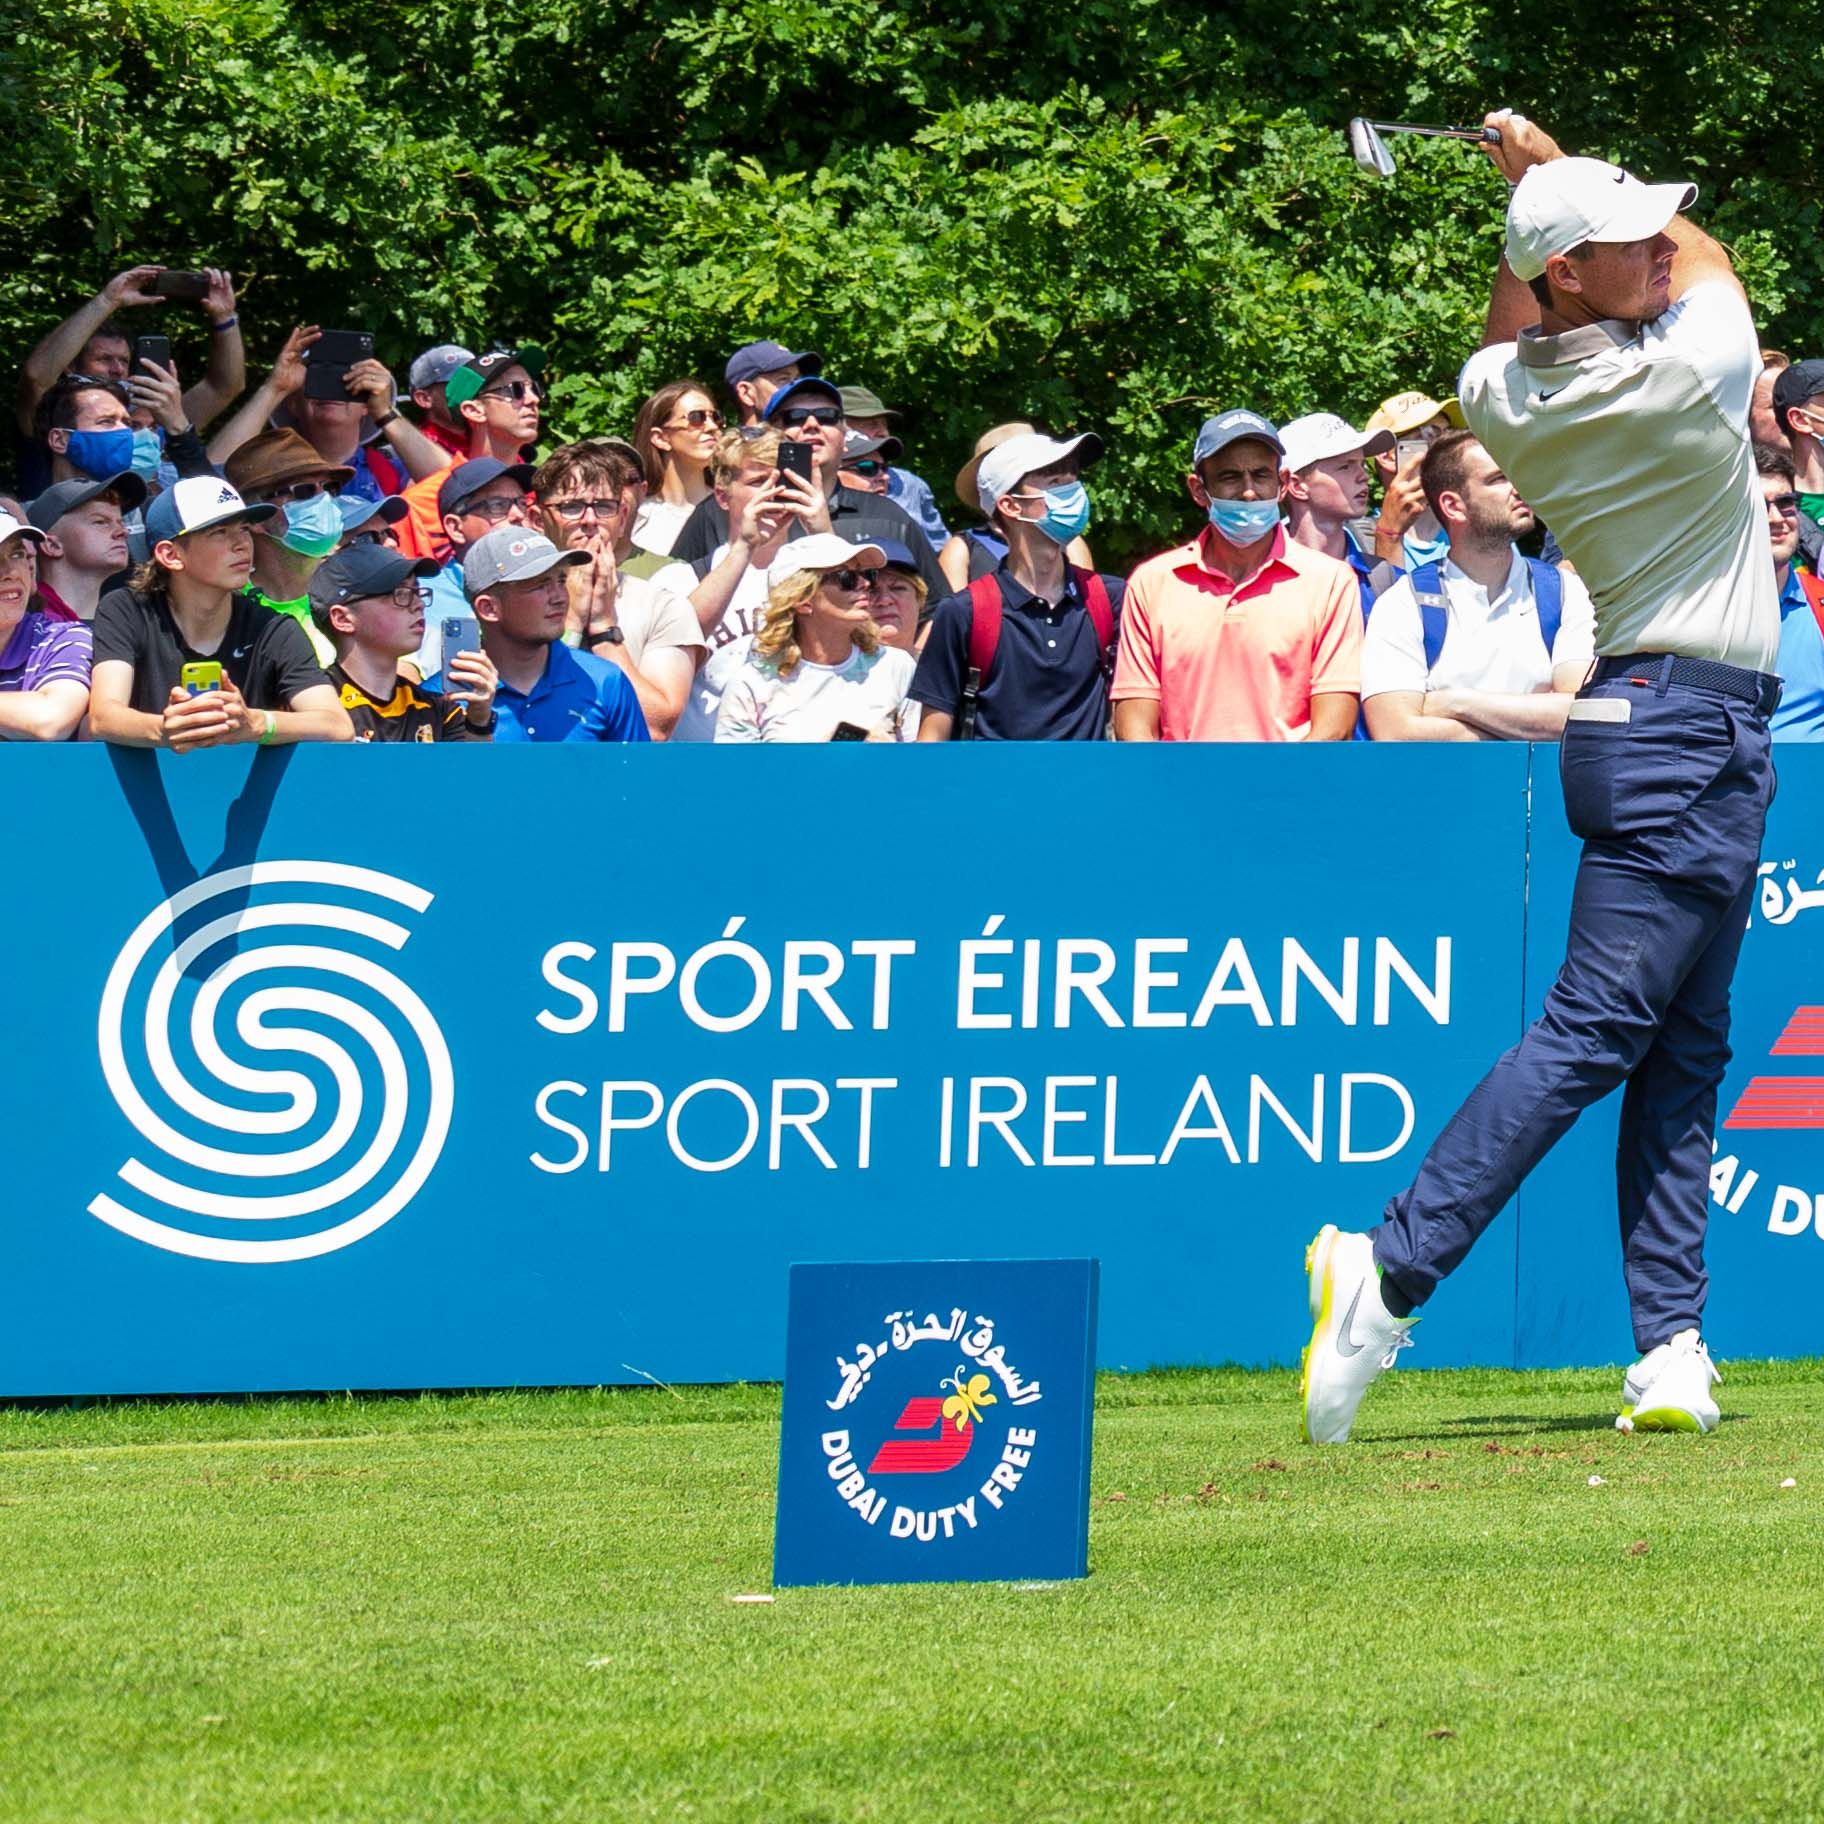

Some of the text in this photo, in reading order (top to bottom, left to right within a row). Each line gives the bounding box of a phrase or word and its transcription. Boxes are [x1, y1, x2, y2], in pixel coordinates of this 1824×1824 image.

[535, 915, 1453, 1034] SPÓRT ÉIREANN
[529, 1072, 1416, 1174] SPORT IRELAND
[821, 1427, 1037, 1542] DUBAI DUTY FREE
